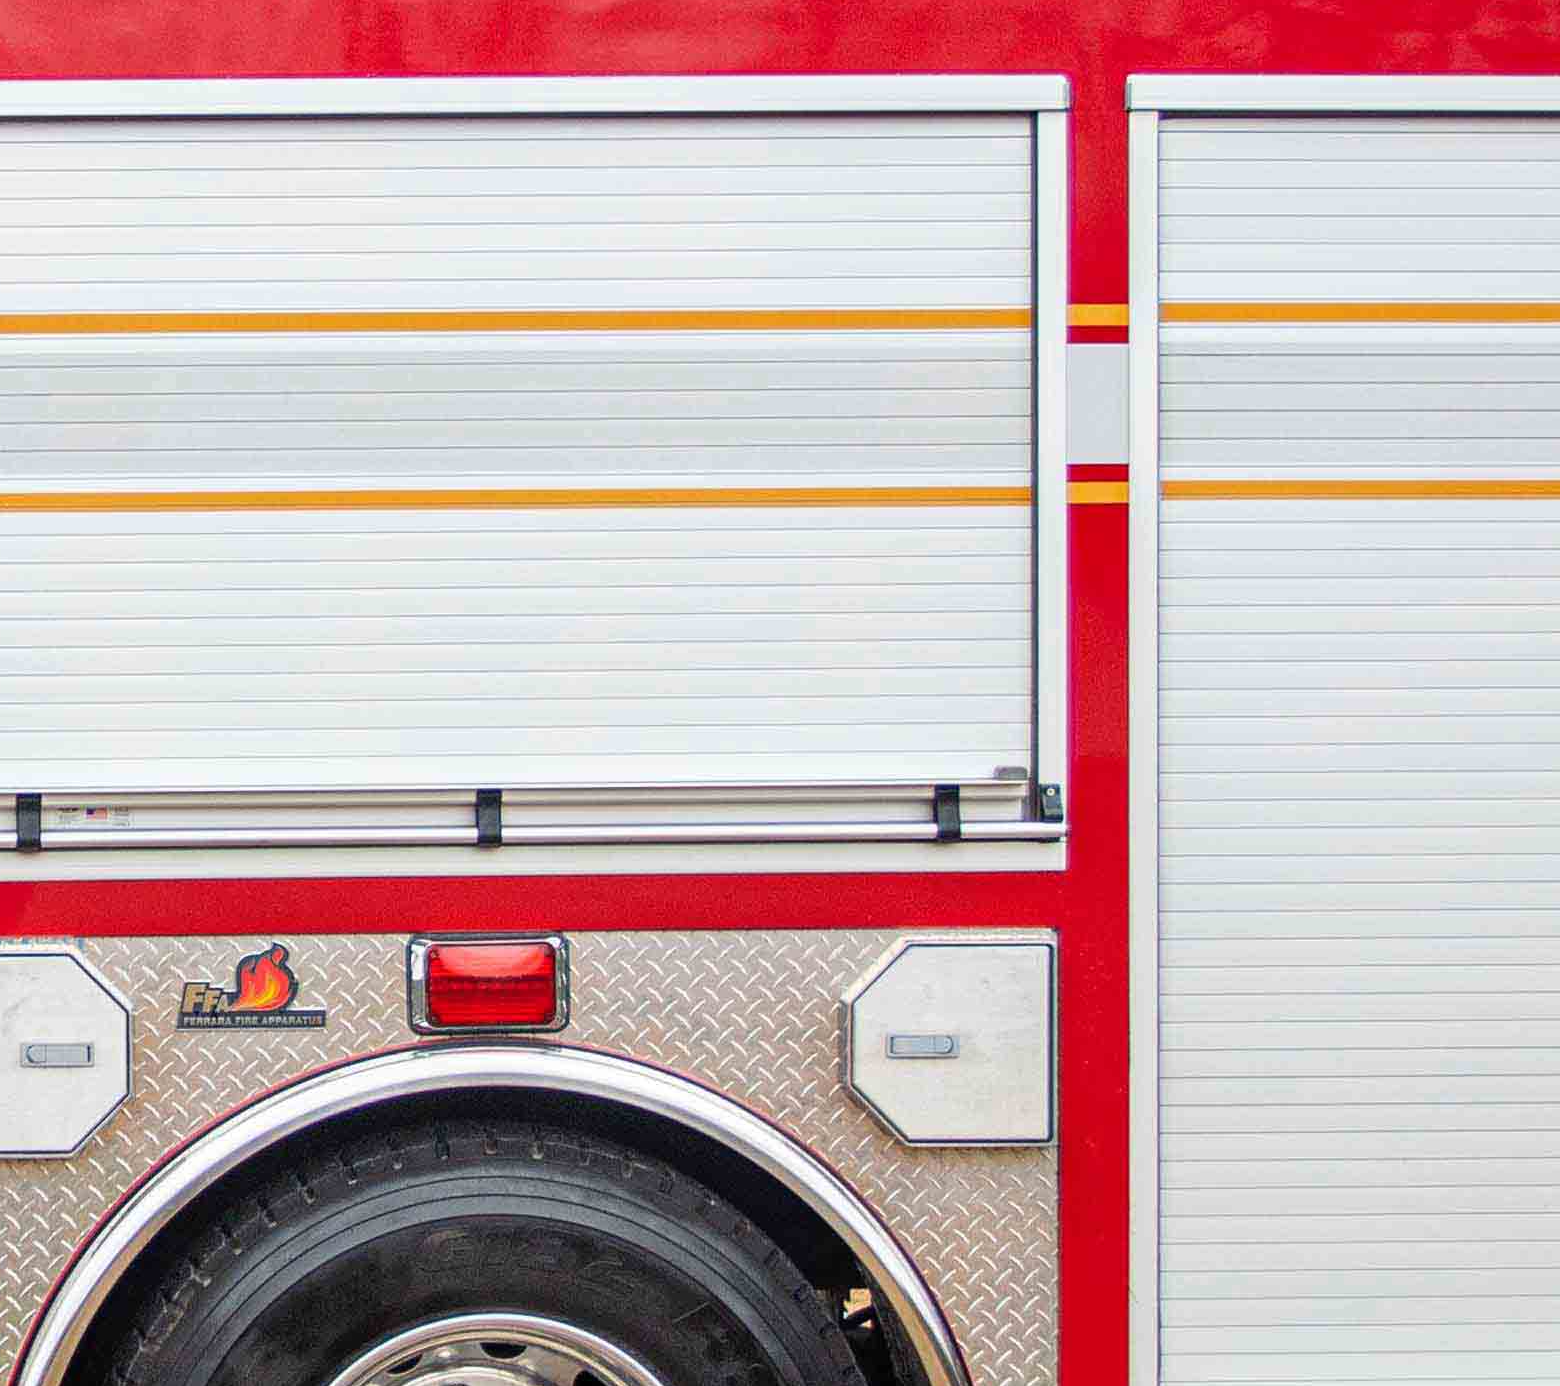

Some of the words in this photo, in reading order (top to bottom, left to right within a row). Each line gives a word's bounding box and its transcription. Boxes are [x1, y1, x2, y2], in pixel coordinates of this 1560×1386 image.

[183, 1016, 232, 1027] FERRARA
[234, 1016, 259, 1026] FIRE
[261, 1015, 323, 1026] APPARATUS
